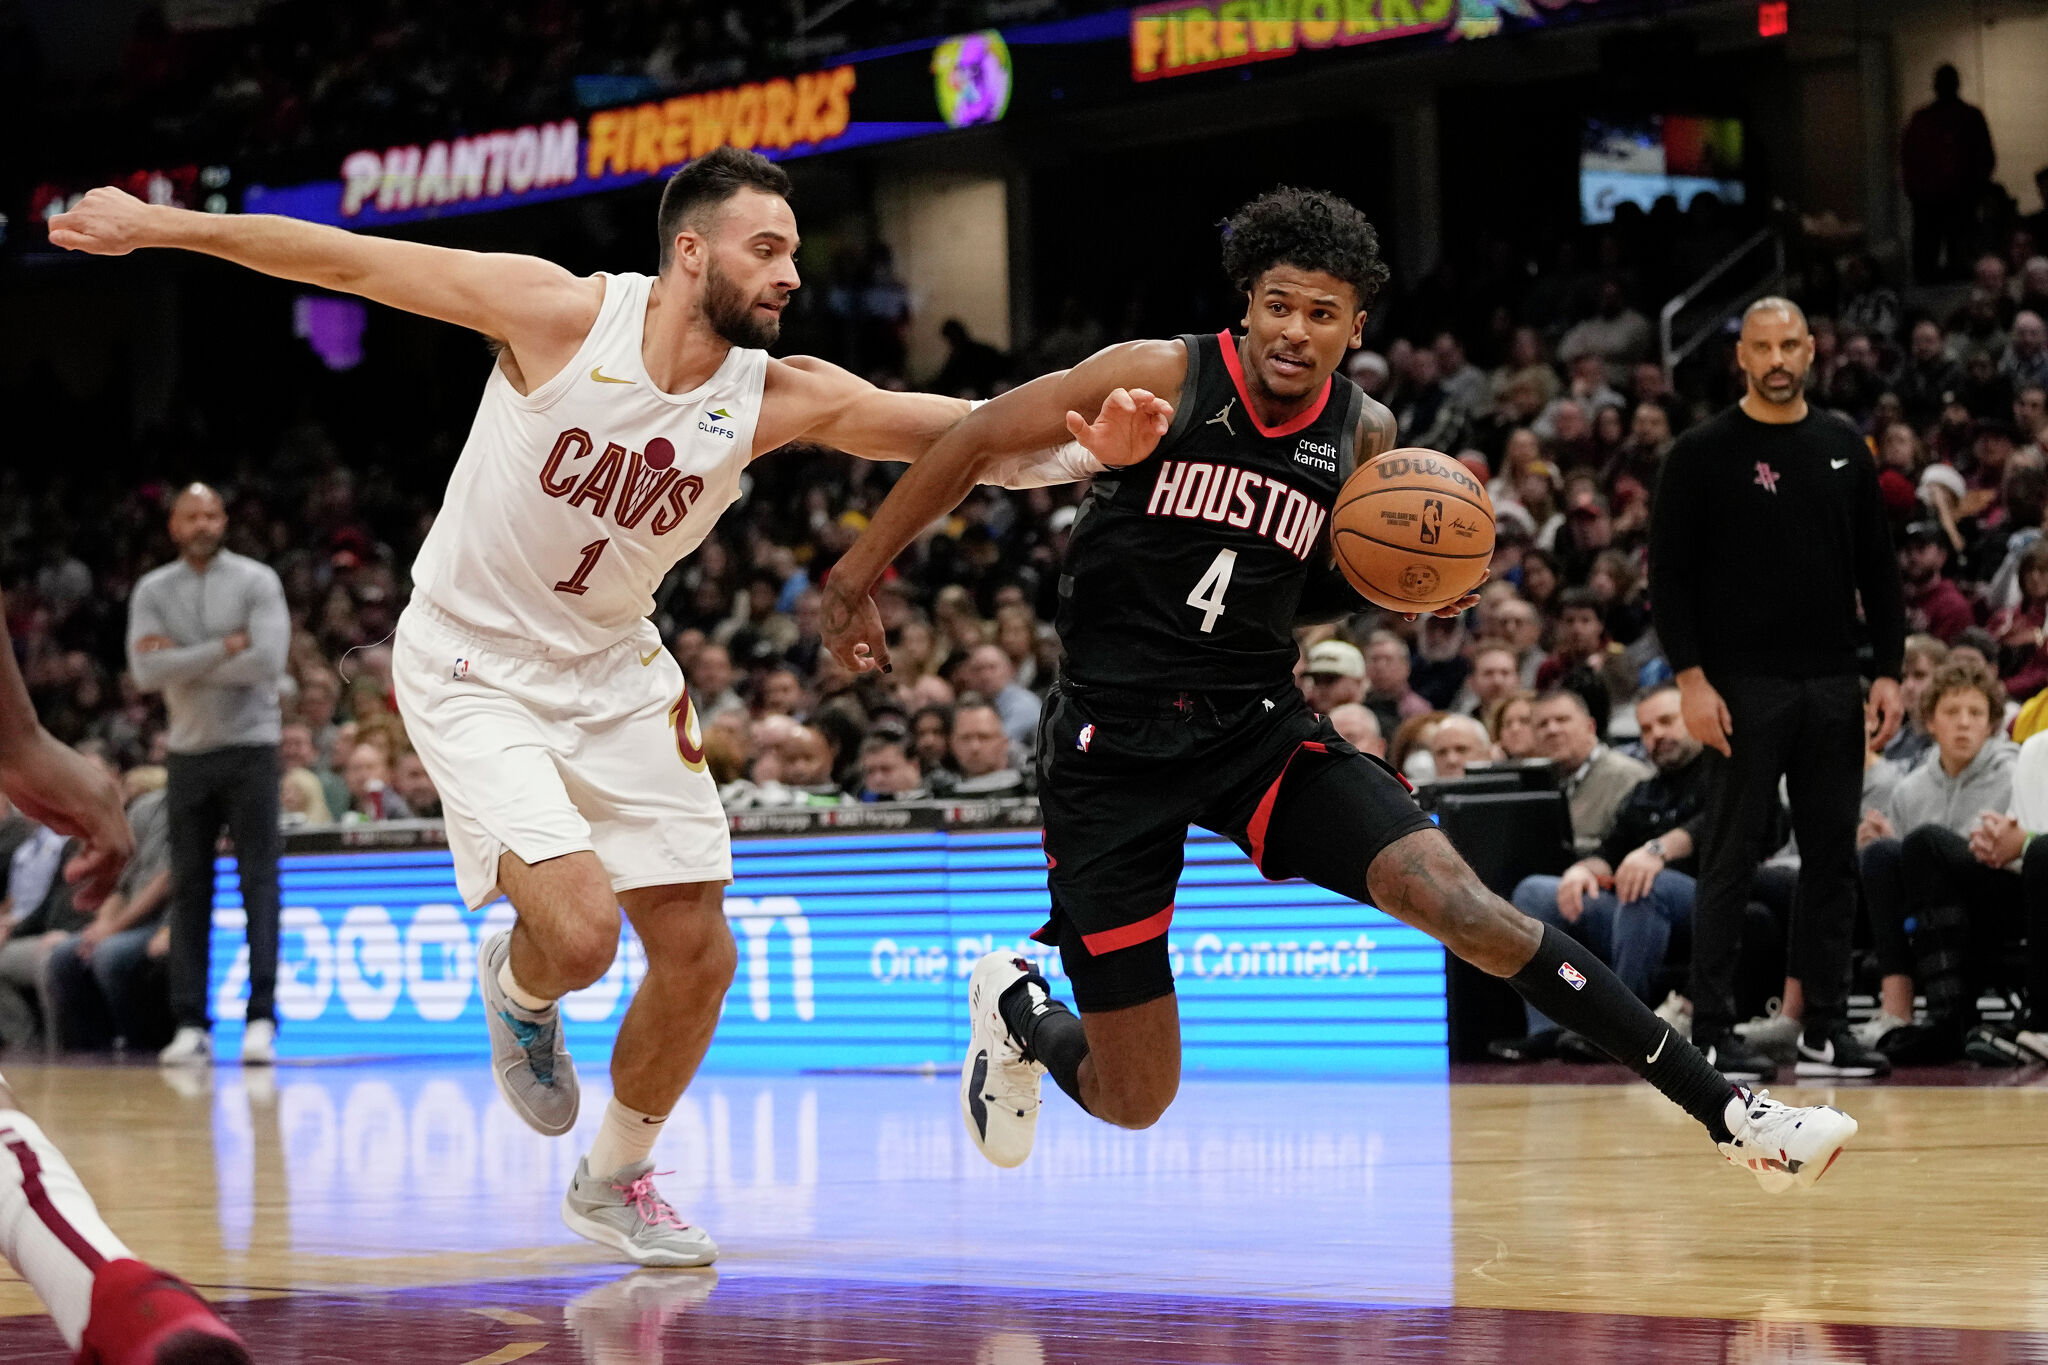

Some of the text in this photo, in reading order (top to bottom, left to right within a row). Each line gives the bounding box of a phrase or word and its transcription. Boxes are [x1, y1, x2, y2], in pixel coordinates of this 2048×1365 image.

[341, 118, 578, 216] PHANTOM
[586, 65, 856, 179] FIREWORKS
[698, 421, 734, 439] CLIFFS
[1299, 438, 1337, 460] credit
[539, 427, 704, 536] CAVS
[1293, 448, 1336, 473] karma
[1376, 457, 1483, 501] Wilson
[1146, 460, 1327, 561] HOUSTON
[553, 538, 610, 596] 1
[1186, 547, 1238, 634] 4
[870, 937, 948, 982] One
[1194, 932, 1378, 982] Connect
